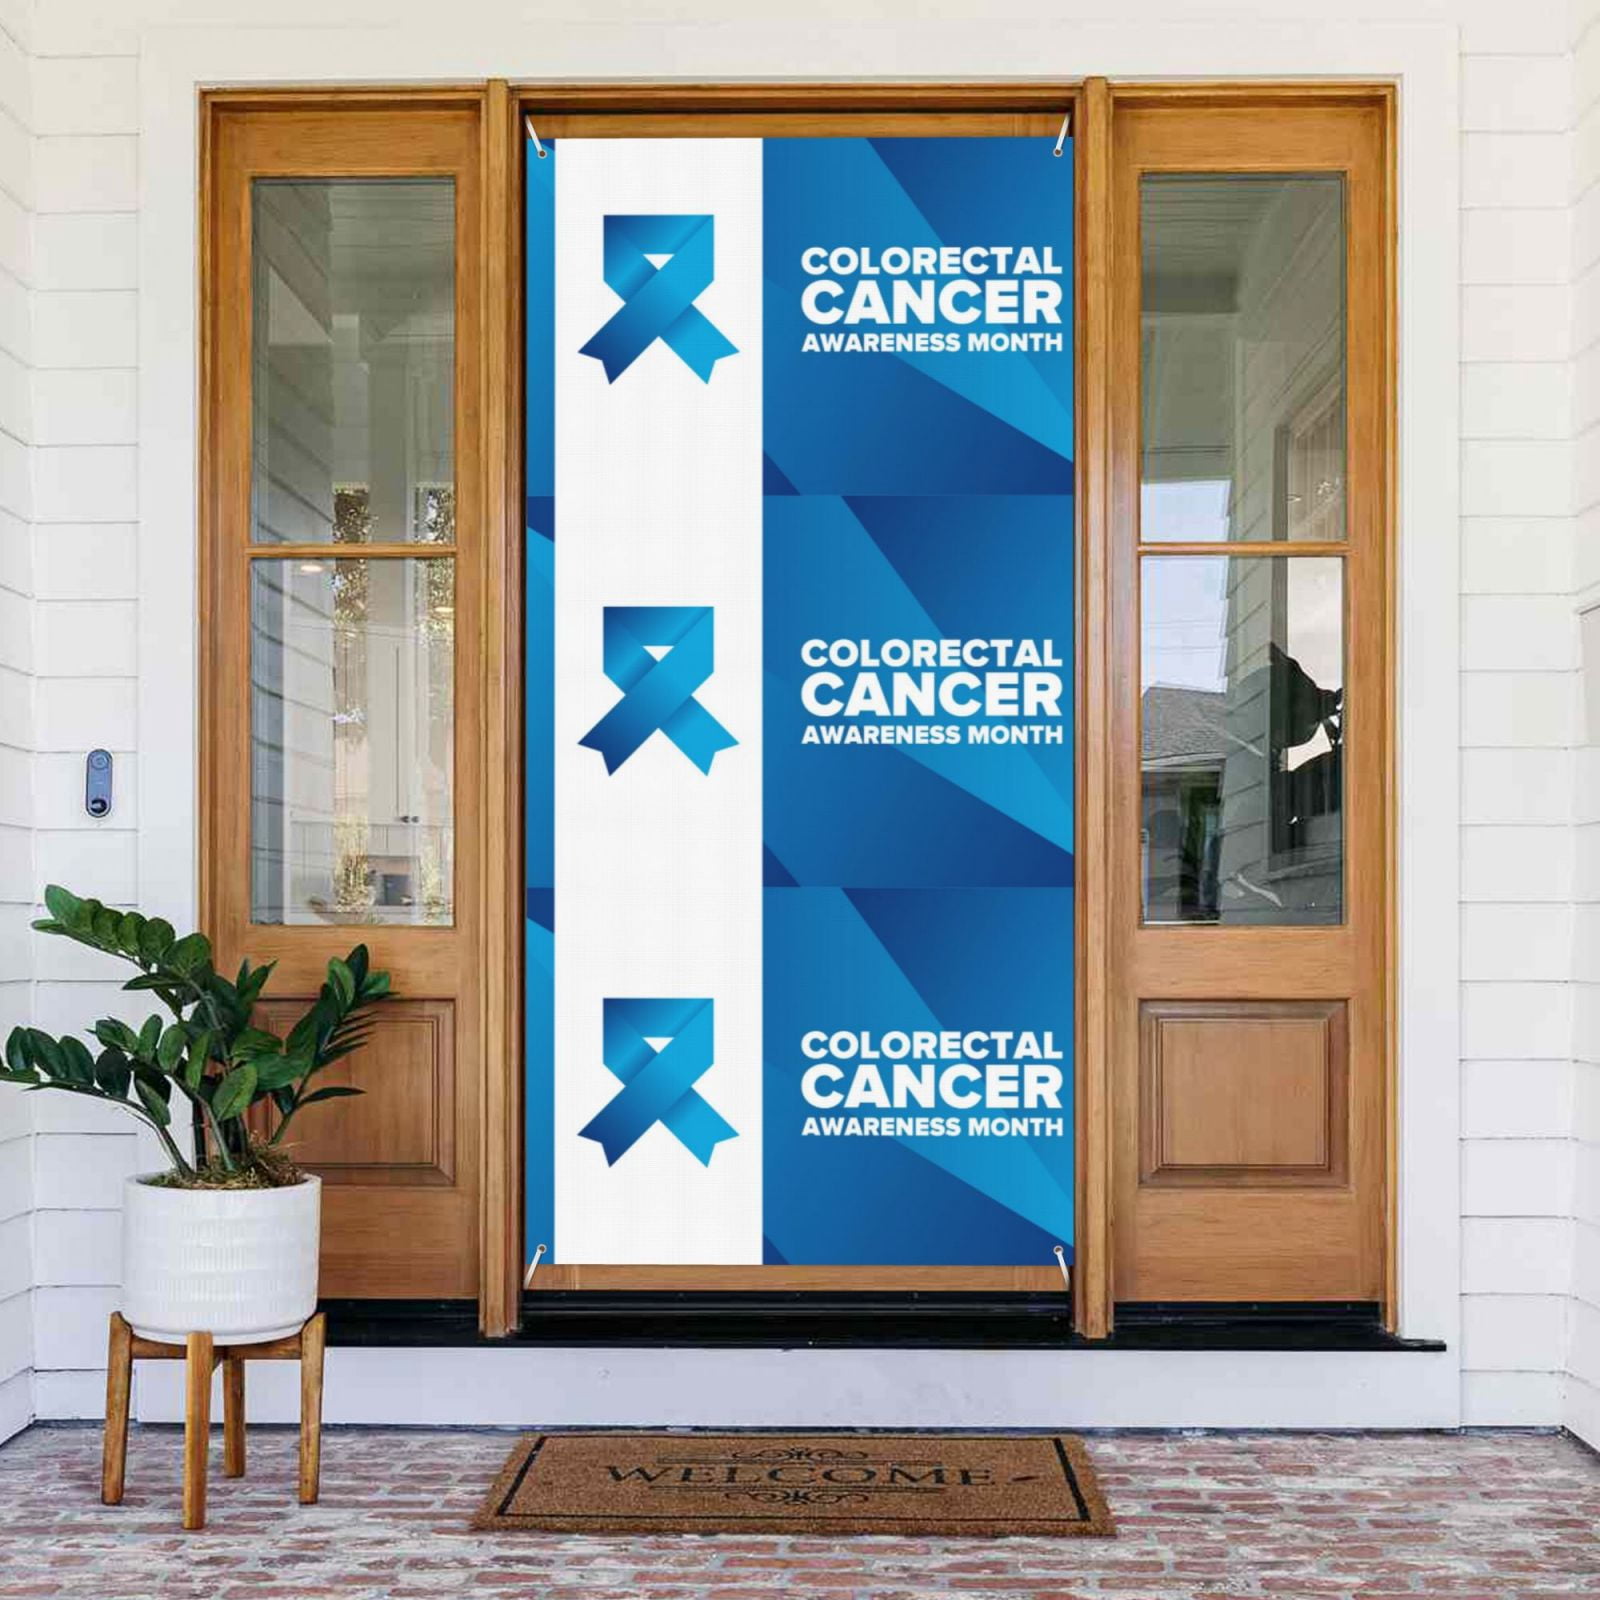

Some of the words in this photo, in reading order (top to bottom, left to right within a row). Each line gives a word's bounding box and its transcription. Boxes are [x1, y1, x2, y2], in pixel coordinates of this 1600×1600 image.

[801, 246, 1063, 275] COLORECTAL
[801, 279, 1063, 325] CANCER
[801, 333, 961, 353] AWARENESS
[968, 333, 1063, 353] MONTH
[801, 638, 1063, 667] COLORECTAL
[801, 671, 1063, 717] CANCER
[801, 725, 961, 745] AWARENESS
[968, 725, 1063, 745] MONTH
[801, 1030, 1063, 1059] COLORECTAL
[801, 1063, 1063, 1109] CANCER
[801, 1117, 961, 1137] AWARENESS
[968, 1117, 1063, 1137] MONTH
[607, 1464, 994, 1486] WELCOME
